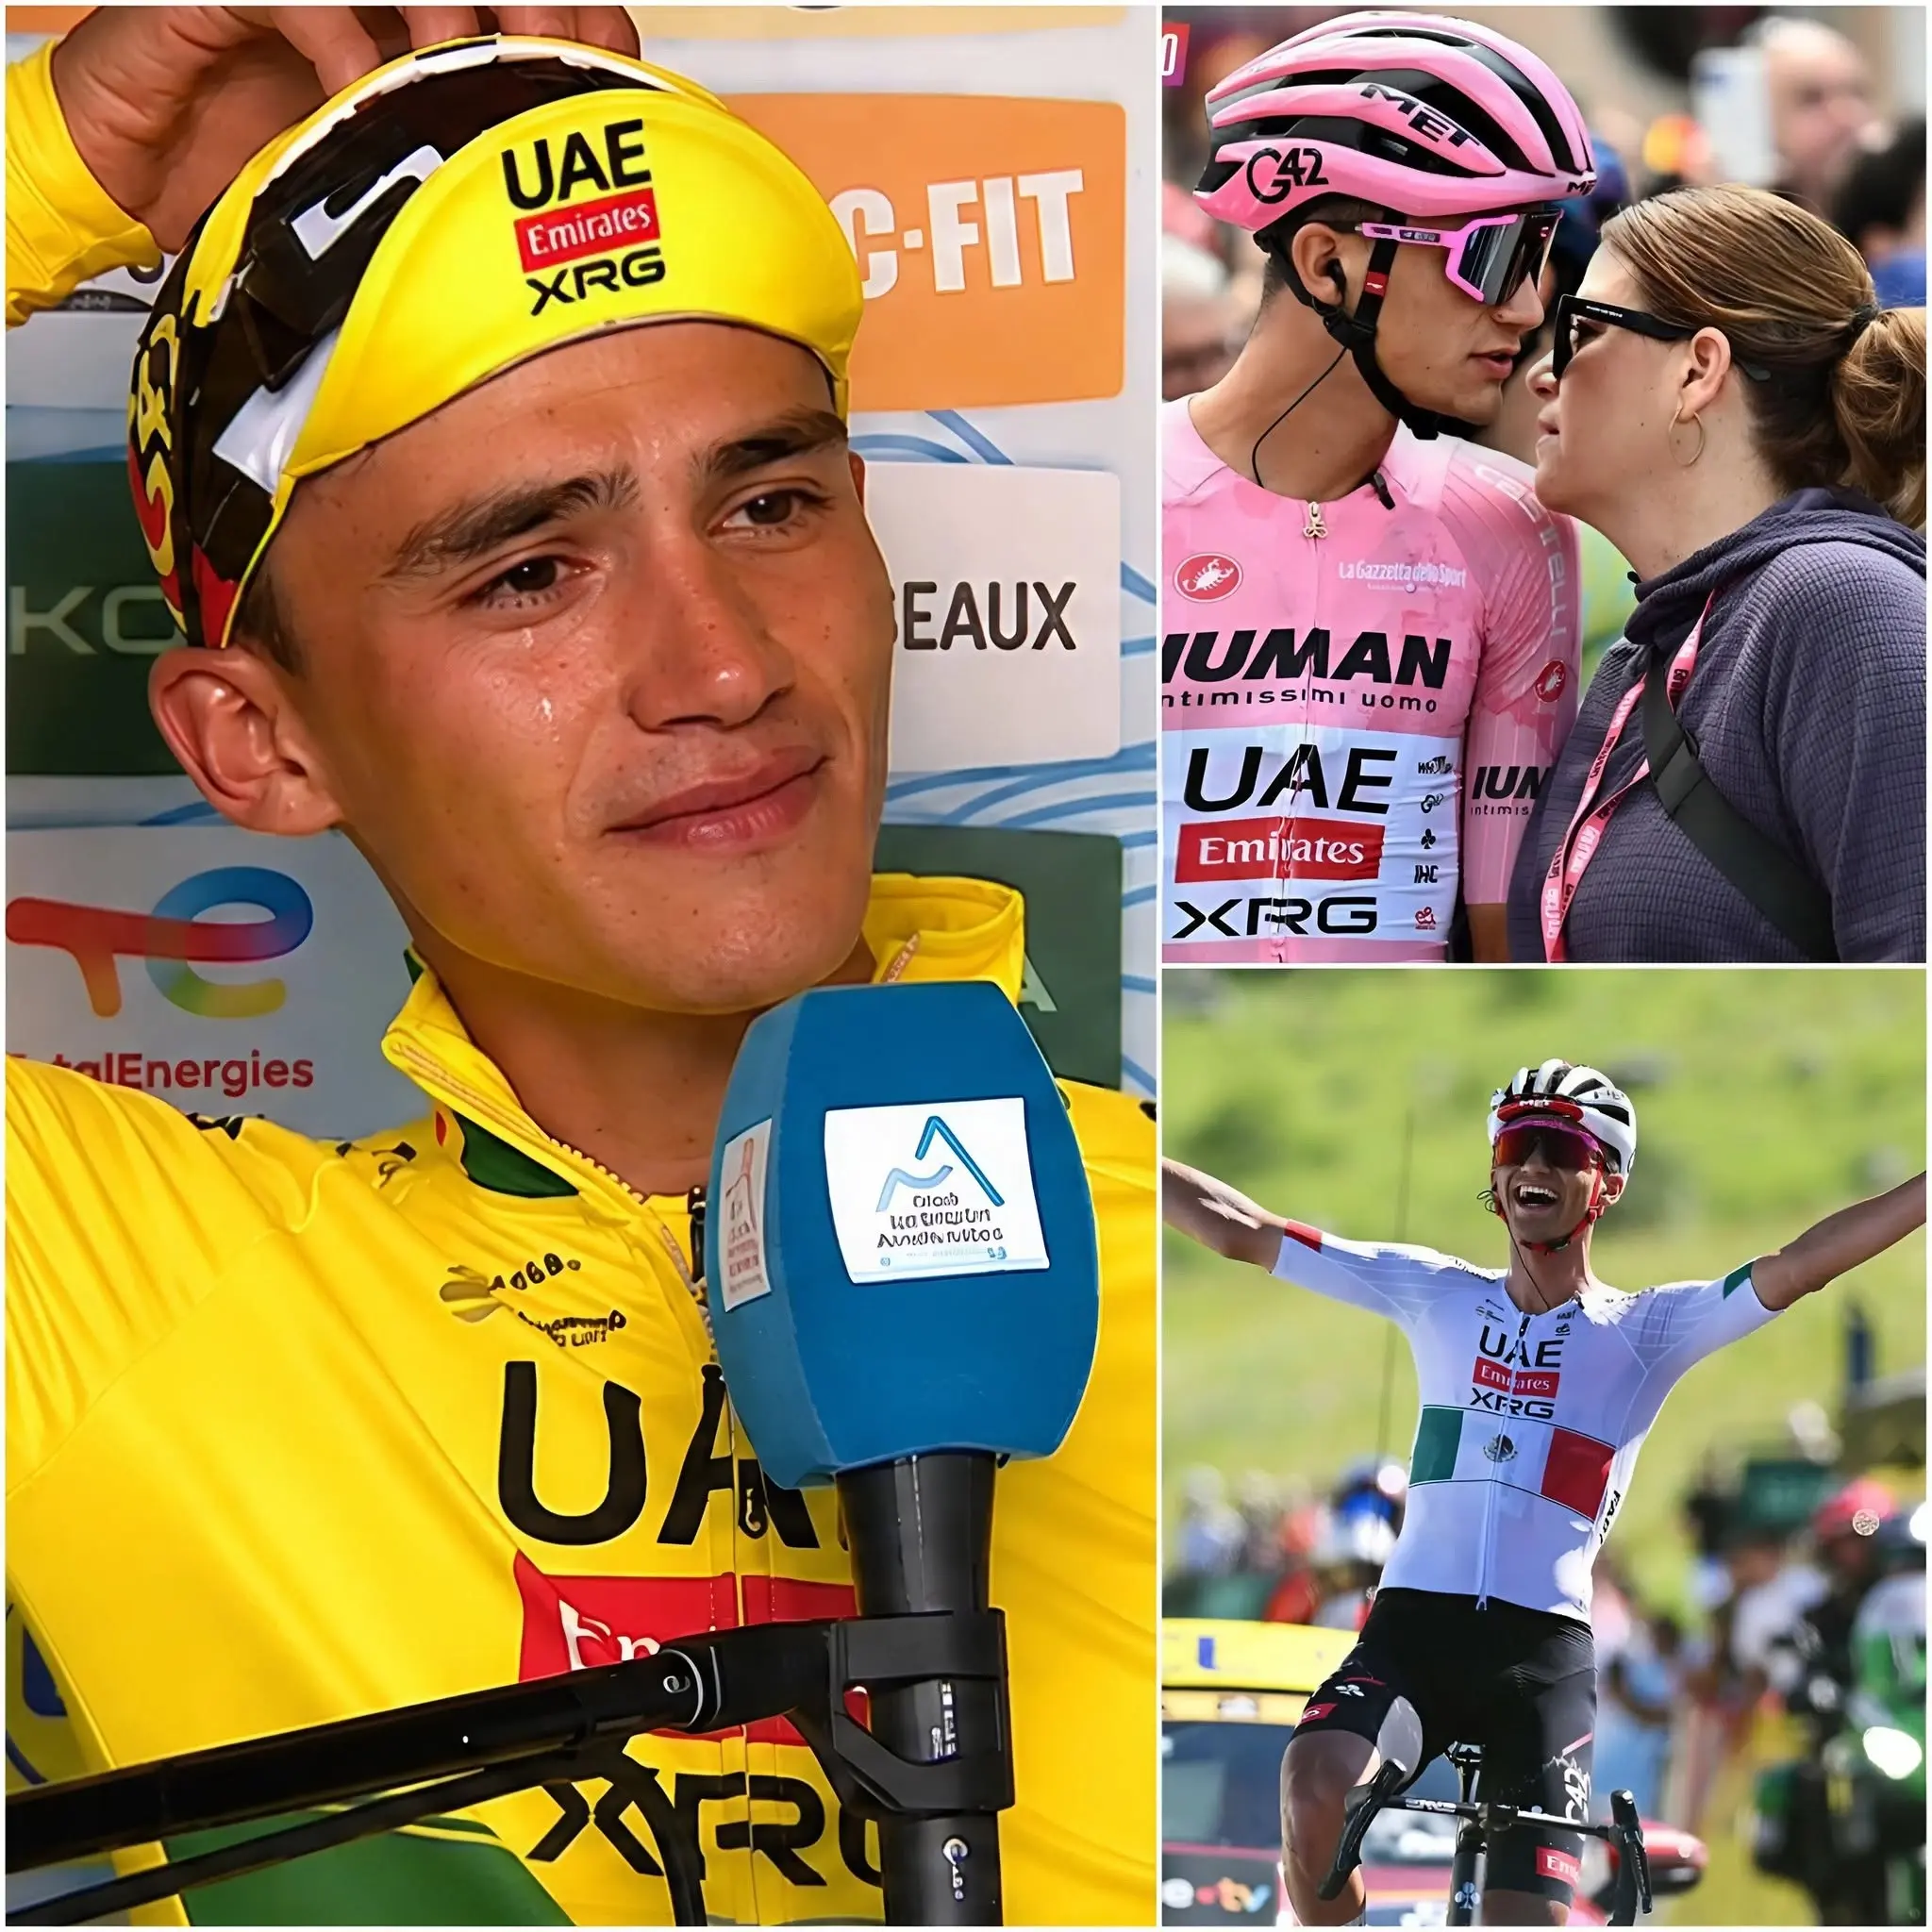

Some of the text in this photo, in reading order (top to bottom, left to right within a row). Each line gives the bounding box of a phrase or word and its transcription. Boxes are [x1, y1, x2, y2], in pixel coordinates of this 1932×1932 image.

[1360, 84, 1480, 147] MET
[501, 119, 652, 209] UAE
[1246, 147, 1329, 204] G42
[526, 203, 652, 257] Emirates
[525, 247, 665, 316] XRG
[892, 581, 1077, 651] EAUX
[1362, 693, 1437, 713] uomo
[1184, 743, 1397, 814] UAE
[1199, 831, 1364, 865] Emirates
[1414, 865, 1438, 883] IHC
[1172, 897, 1377, 939] XRG
[1479, 1325, 1564, 1368] UAE
[1470, 1388, 1555, 1419] XRG
[498, 1361, 849, 1548] UA
